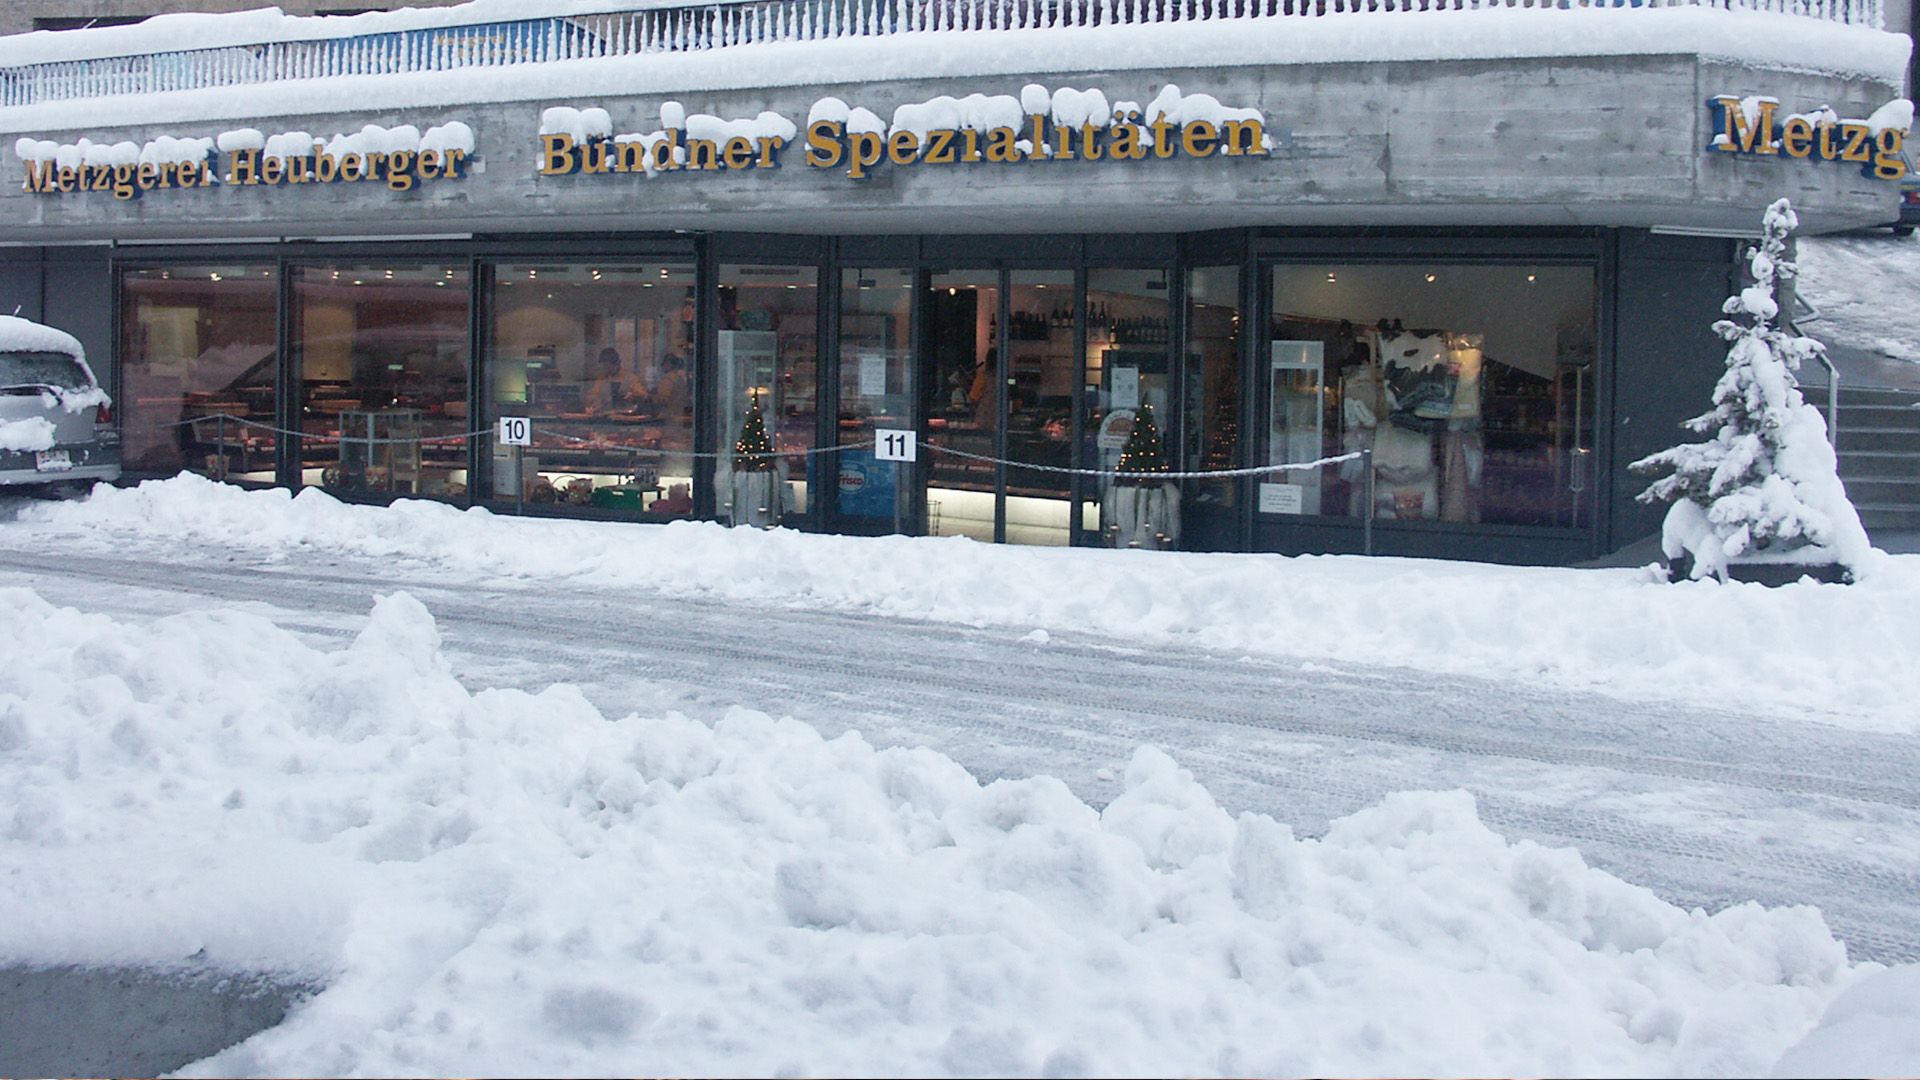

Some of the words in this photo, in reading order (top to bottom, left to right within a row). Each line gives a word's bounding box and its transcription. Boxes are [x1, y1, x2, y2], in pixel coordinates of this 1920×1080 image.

[540, 127, 782, 176] Bündner
[806, 110, 1268, 178] Spezialitäten
[1710, 97, 1910, 180] Metzg
[23, 159, 213, 200] Metzgerei
[227, 144, 465, 191] Heuberger
[505, 419, 525, 440] 10
[884, 434, 905, 457] 11
